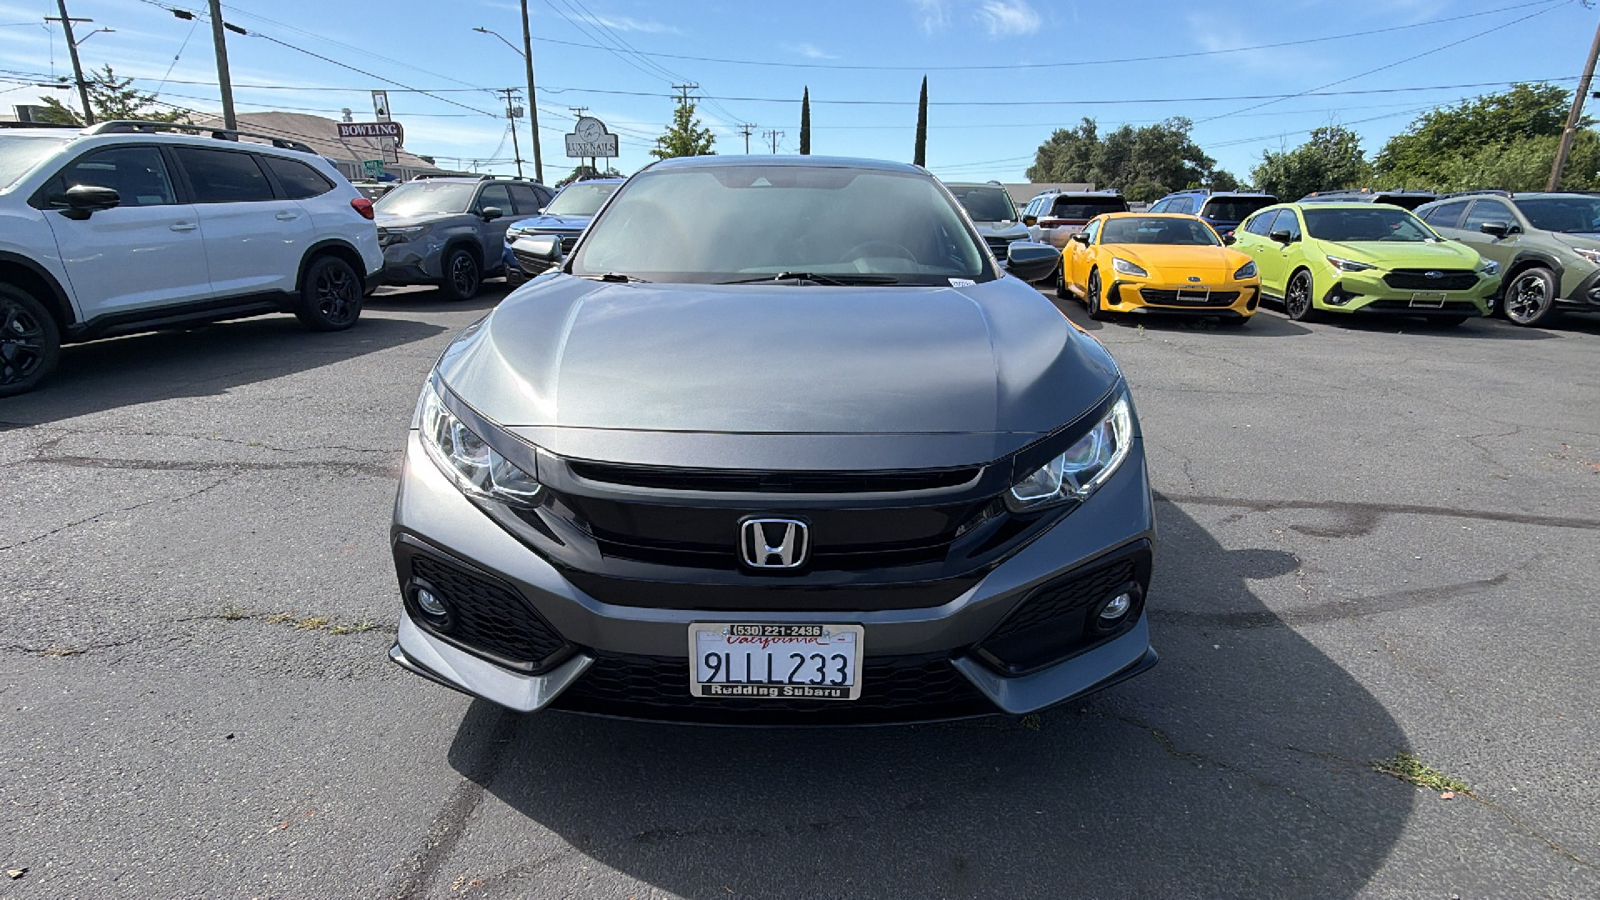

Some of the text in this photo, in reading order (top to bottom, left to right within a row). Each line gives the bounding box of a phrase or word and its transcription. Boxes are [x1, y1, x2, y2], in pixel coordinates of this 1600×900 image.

[341, 124, 397, 136] BOWLING
[567, 143, 615, 152] LUXE NAILS
[733, 626, 821, 636] (530) 221-2436
[704, 652, 847, 685] 9LLL233
[711, 685, 841, 697] Redding Subaru
